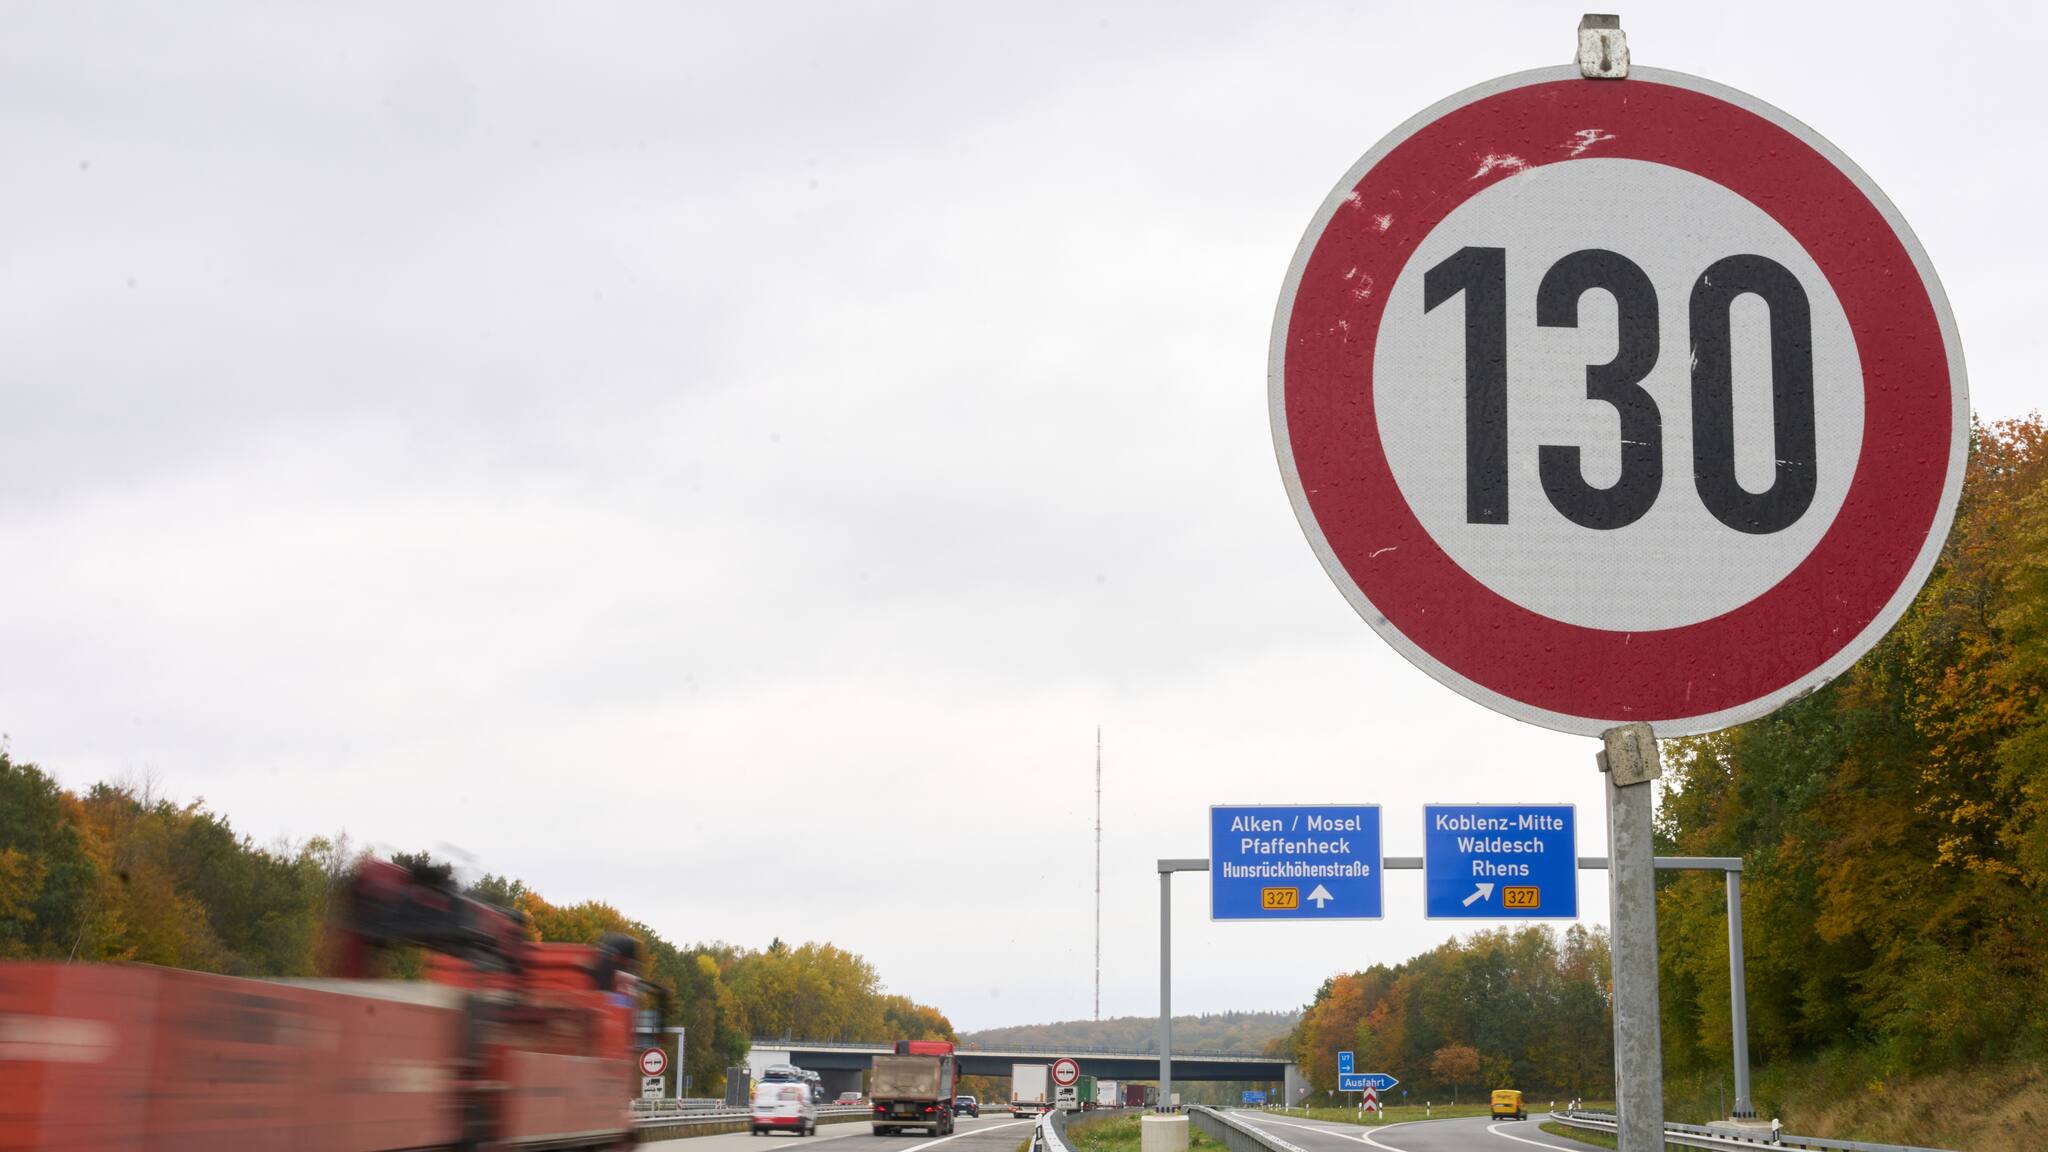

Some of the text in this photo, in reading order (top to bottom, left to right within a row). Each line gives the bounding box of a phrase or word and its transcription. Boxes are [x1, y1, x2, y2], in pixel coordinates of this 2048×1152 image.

[1424, 246, 1817, 535] 130
[1231, 815, 1362, 832] Alken / Mosel
[1436, 814, 1563, 831] Koblenz-Mitte
[1241, 837, 1351, 855] Pfaffenheck
[1457, 836, 1544, 853] Waldesch
[1223, 860, 1370, 878] Hunsrückhöhenstraße
[1472, 860, 1529, 876] Rhens
[1267, 891, 1293, 905] 327
[1508, 890, 1535, 904] 327
[1344, 1078, 1385, 1087] Ausfahrt
